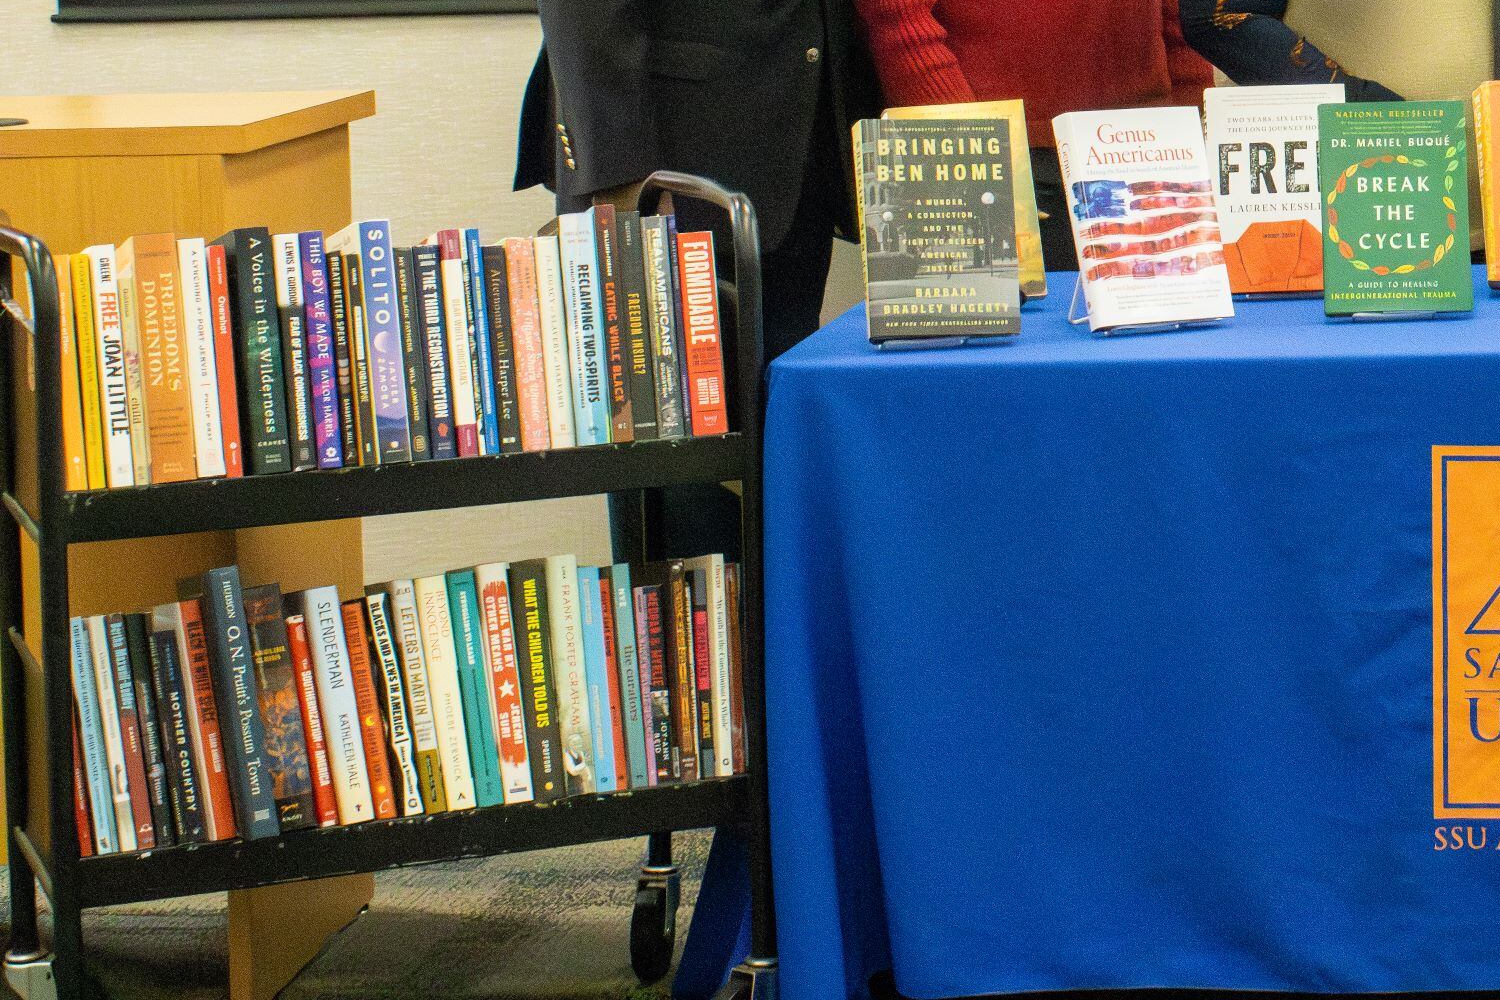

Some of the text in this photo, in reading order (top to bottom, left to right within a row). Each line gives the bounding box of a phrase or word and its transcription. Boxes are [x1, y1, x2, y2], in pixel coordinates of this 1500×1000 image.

[877, 138, 1000, 156] BRINGING
[1086, 144, 1193, 165] Americanus
[1097, 124, 1156, 144] Genus
[1331, 135, 1450, 148] DR. MARIEL BUQUÉ
[877, 163, 1003, 181] BEN HOME
[1219, 141, 1320, 195] FRE
[1356, 176, 1430, 192] BREAK
[1230, 204, 1277, 213] LAUREN
[1374, 205, 1414, 220] THE
[1359, 233, 1430, 250] CYCLE
[367, 229, 390, 325] SOLITO
[577, 264, 594, 333] RECLAIMING
[650, 227, 672, 357] REAL AMERICANS
[683, 241, 716, 344] FORMIDABLE
[916, 288, 976, 298] BARBARA
[1331, 292, 1418, 300] INTERGENERATIONAL
[99, 292, 118, 330] FREE
[142, 281, 164, 387] DOMINION
[160, 272, 182, 392] FREEDOM'S
[628, 293, 647, 375] FREEDOM INSIDE?
[884, 303, 1009, 314] BRADLEY HAGERTY
[103, 335, 122, 380] JOAN
[249, 238, 276, 433] A Voice in the Wilderness
[308, 237, 333, 438] THIS BOY WE MADE TAYLOR HARRIS
[422, 270, 449, 418] THE THIRD RECONSTRUCTION
[605, 282, 623, 402] EATING WHILE BLACK
[583, 335, 600, 403] TWO-SPIRITS
[105, 383, 129, 437] LITTLE
[435, 591, 449, 638] BEYOND
[523, 579, 536, 605] WHAT
[424, 593, 441, 662] INNOCENCE
[484, 596, 503, 672] OTHER MEANS
[497, 596, 514, 668] CIVIL WAR BY
[525, 608, 537, 629] THE
[370, 602, 402, 738] BLACKS AND JEWS IN AMERICA
[401, 607, 427, 716] LETTERS TO MARTIN
[527, 631, 544, 682] CHILDREN
[221, 580, 262, 795] HUDSON O. N. Pruitt's Possum Town
[317, 603, 360, 790] SLENDERMAN KATHLEEN HALE
[532, 684, 546, 712] TOLD
[499, 711, 511, 738] SURI
[510, 703, 522, 745] JEREMI
[536, 714, 549, 728] US
[170, 690, 196, 811] MOTHER COUNTRY
[1433, 826, 1488, 851] SSU
